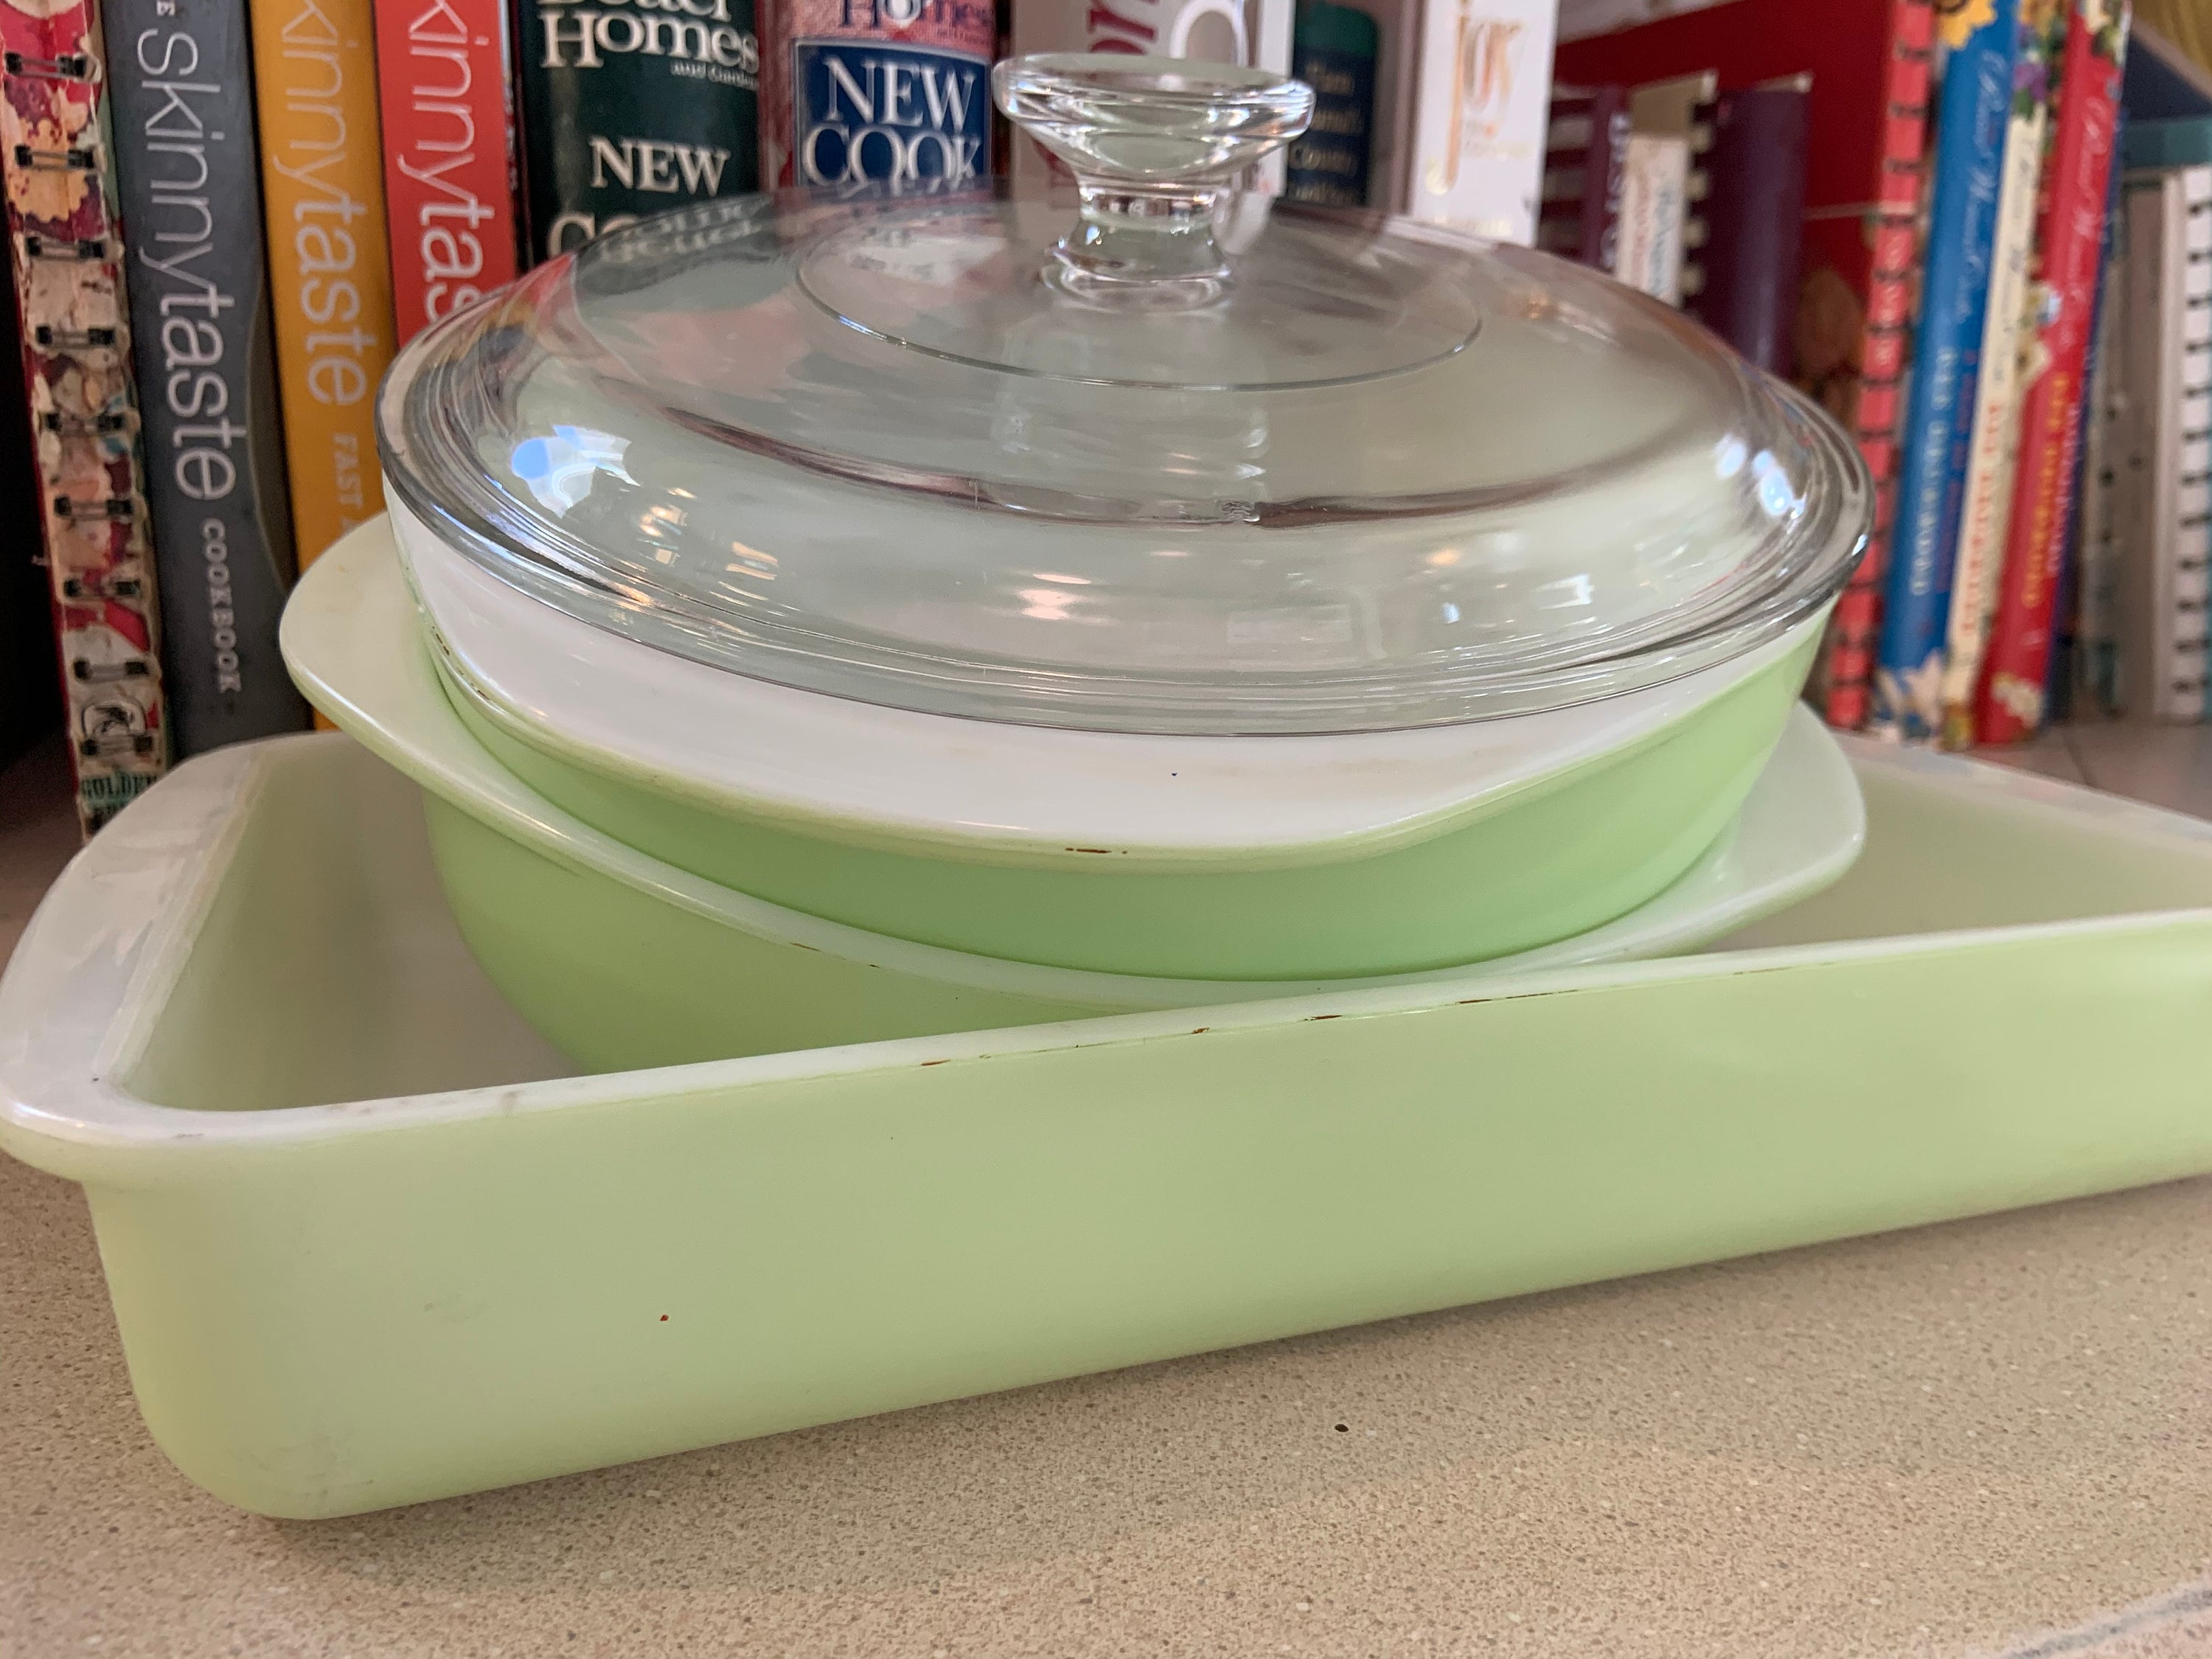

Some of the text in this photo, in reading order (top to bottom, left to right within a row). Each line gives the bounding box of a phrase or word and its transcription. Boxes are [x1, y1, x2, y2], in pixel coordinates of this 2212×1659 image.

[538, 7, 759, 74] Homes
[822, 55, 975, 134] NEW
[395, 0, 495, 325] kinnytas
[589, 136, 731, 197] NEW
[801, 122, 981, 190] COOK
[272, 0, 377, 406] kinnytaste
[136, 27, 247, 501] skinnytaste
[333, 432, 363, 510] FAST
[202, 518, 241, 695] COOKBOOK
